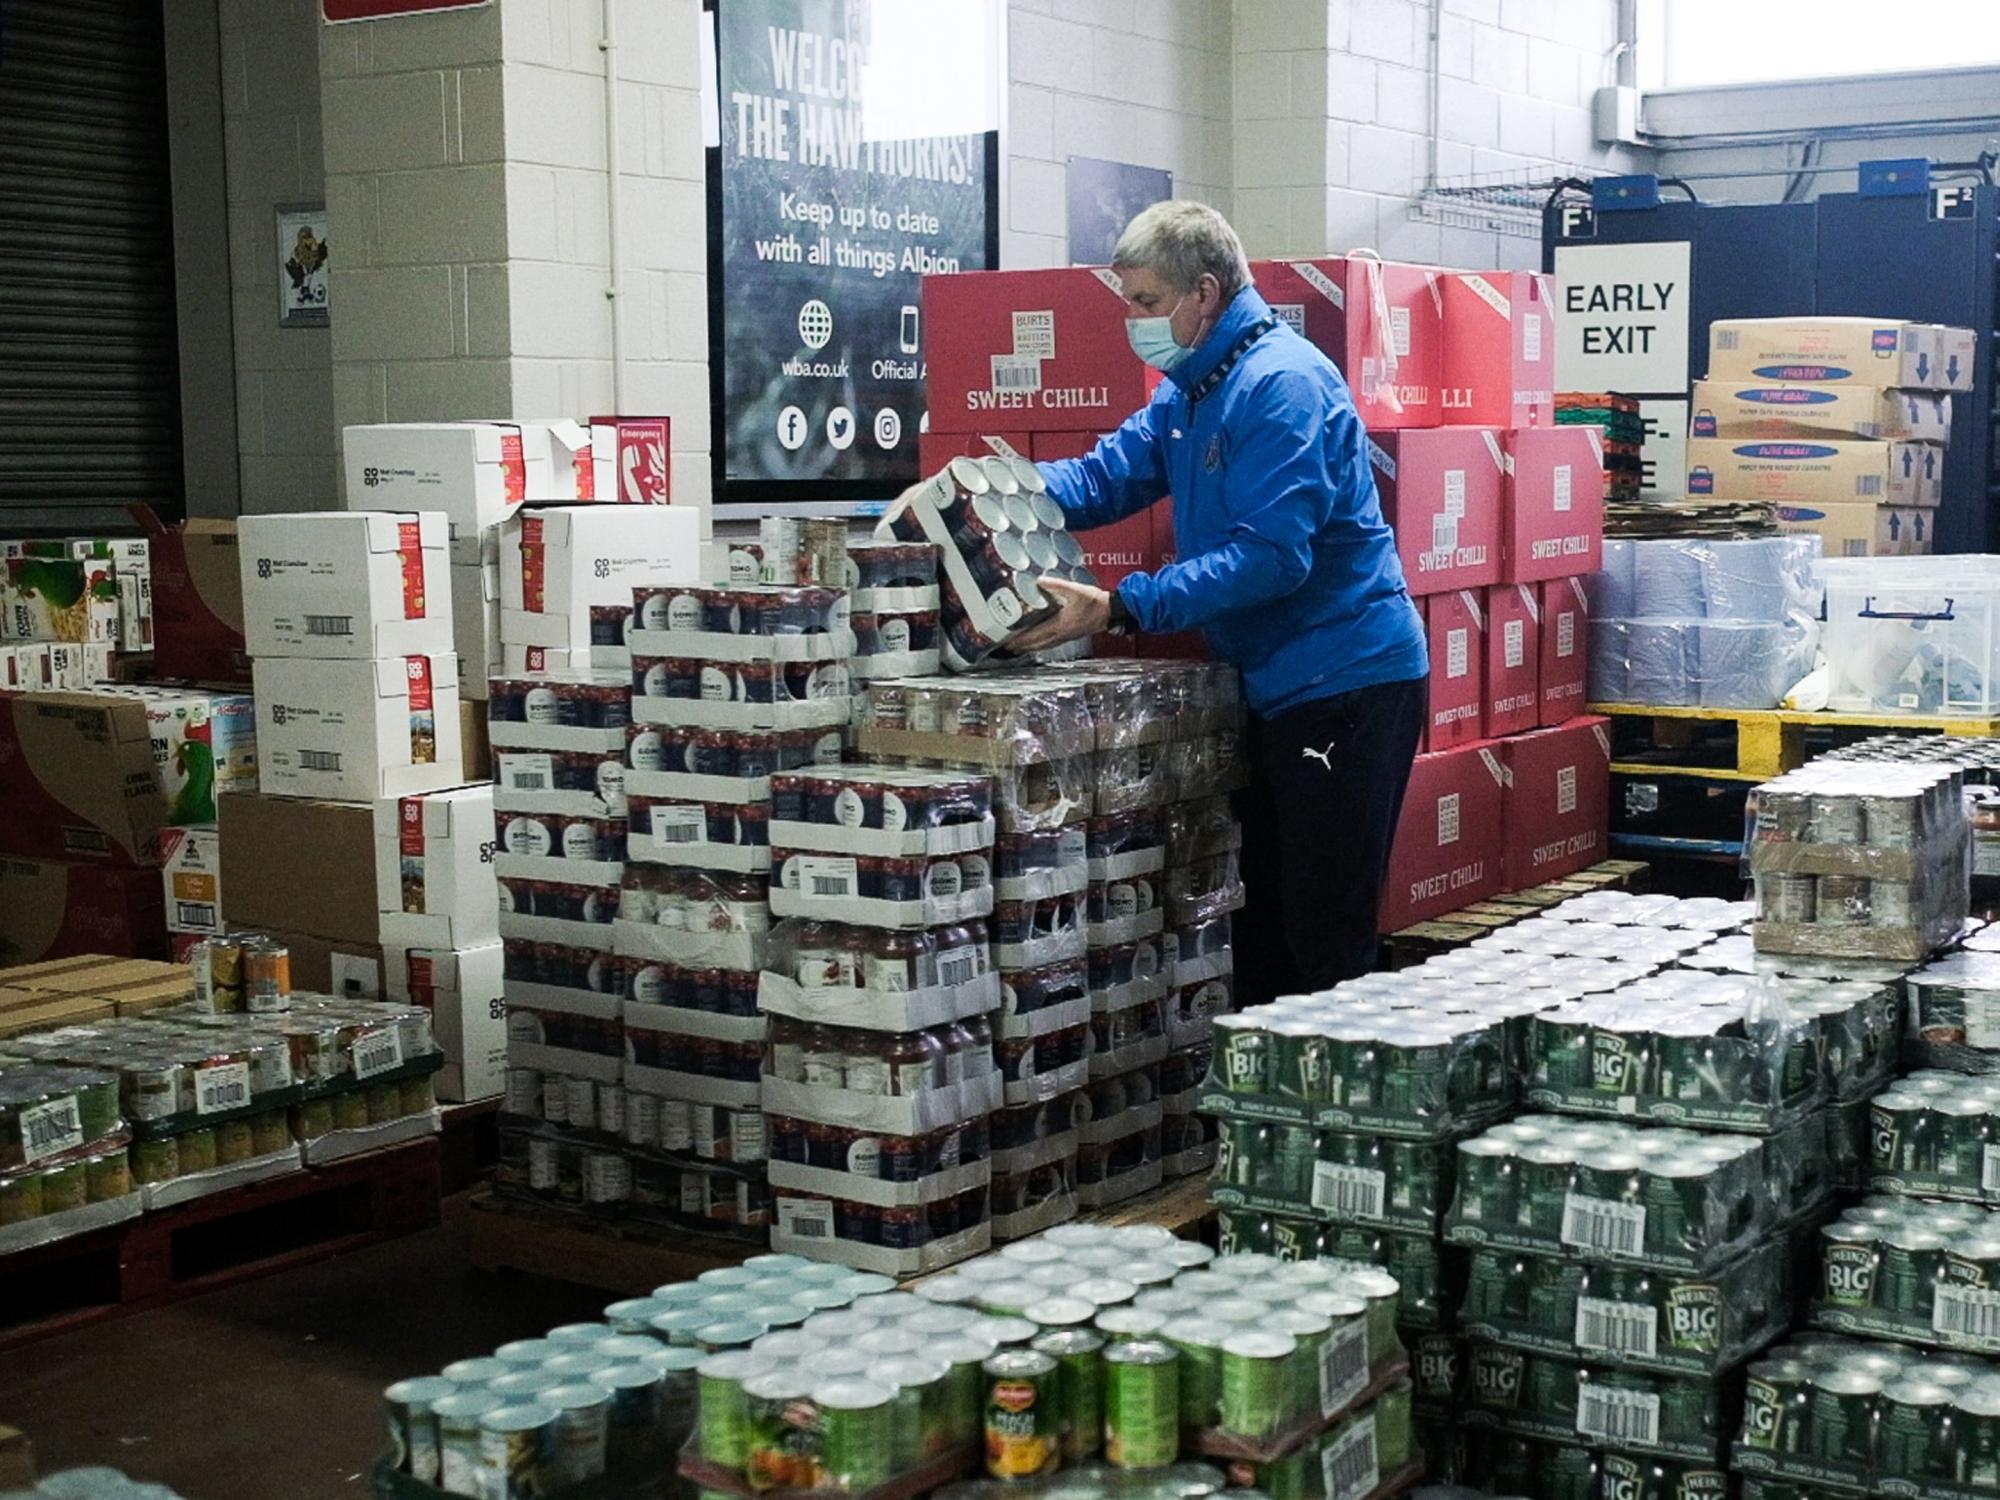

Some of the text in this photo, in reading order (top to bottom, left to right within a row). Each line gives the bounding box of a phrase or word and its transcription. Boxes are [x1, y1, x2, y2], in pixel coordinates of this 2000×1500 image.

[768, 26, 865, 100] WELCO
[732, 92, 790, 162] THE
[779, 192, 940, 235] Keep up to date
[755, 233, 960, 278] with all things Albion
[1566, 283, 1674, 313] EARLY
[1583, 326, 1656, 355] EXIT
[781, 356, 850, 378] wba.co.uk
[871, 359, 918, 380] Official
[966, 387, 1110, 410] SWEET CHILLI
[1441, 388, 1472, 408] LLI
[620, 428, 661, 440] Emergency
[1098, 552, 1142, 566] CHILLI
[1418, 545, 1487, 572] SWEET CHILLI
[1531, 534, 1590, 560] SWEET CHILLI
[151, 738, 168, 750] RN
[1532, 830, 1597, 866] SWEET CHILLI
[1410, 861, 1484, 904] SWEET CHILLI
[1871, 1128, 1891, 1154] IG
[1830, 1249, 1867, 1263] HEINZ
[1828, 1264, 1870, 1290] BIG
[1673, 1307, 1717, 1331] BIG
[1475, 1365, 1516, 1391] BIG
[1749, 1403, 1773, 1431] IG
